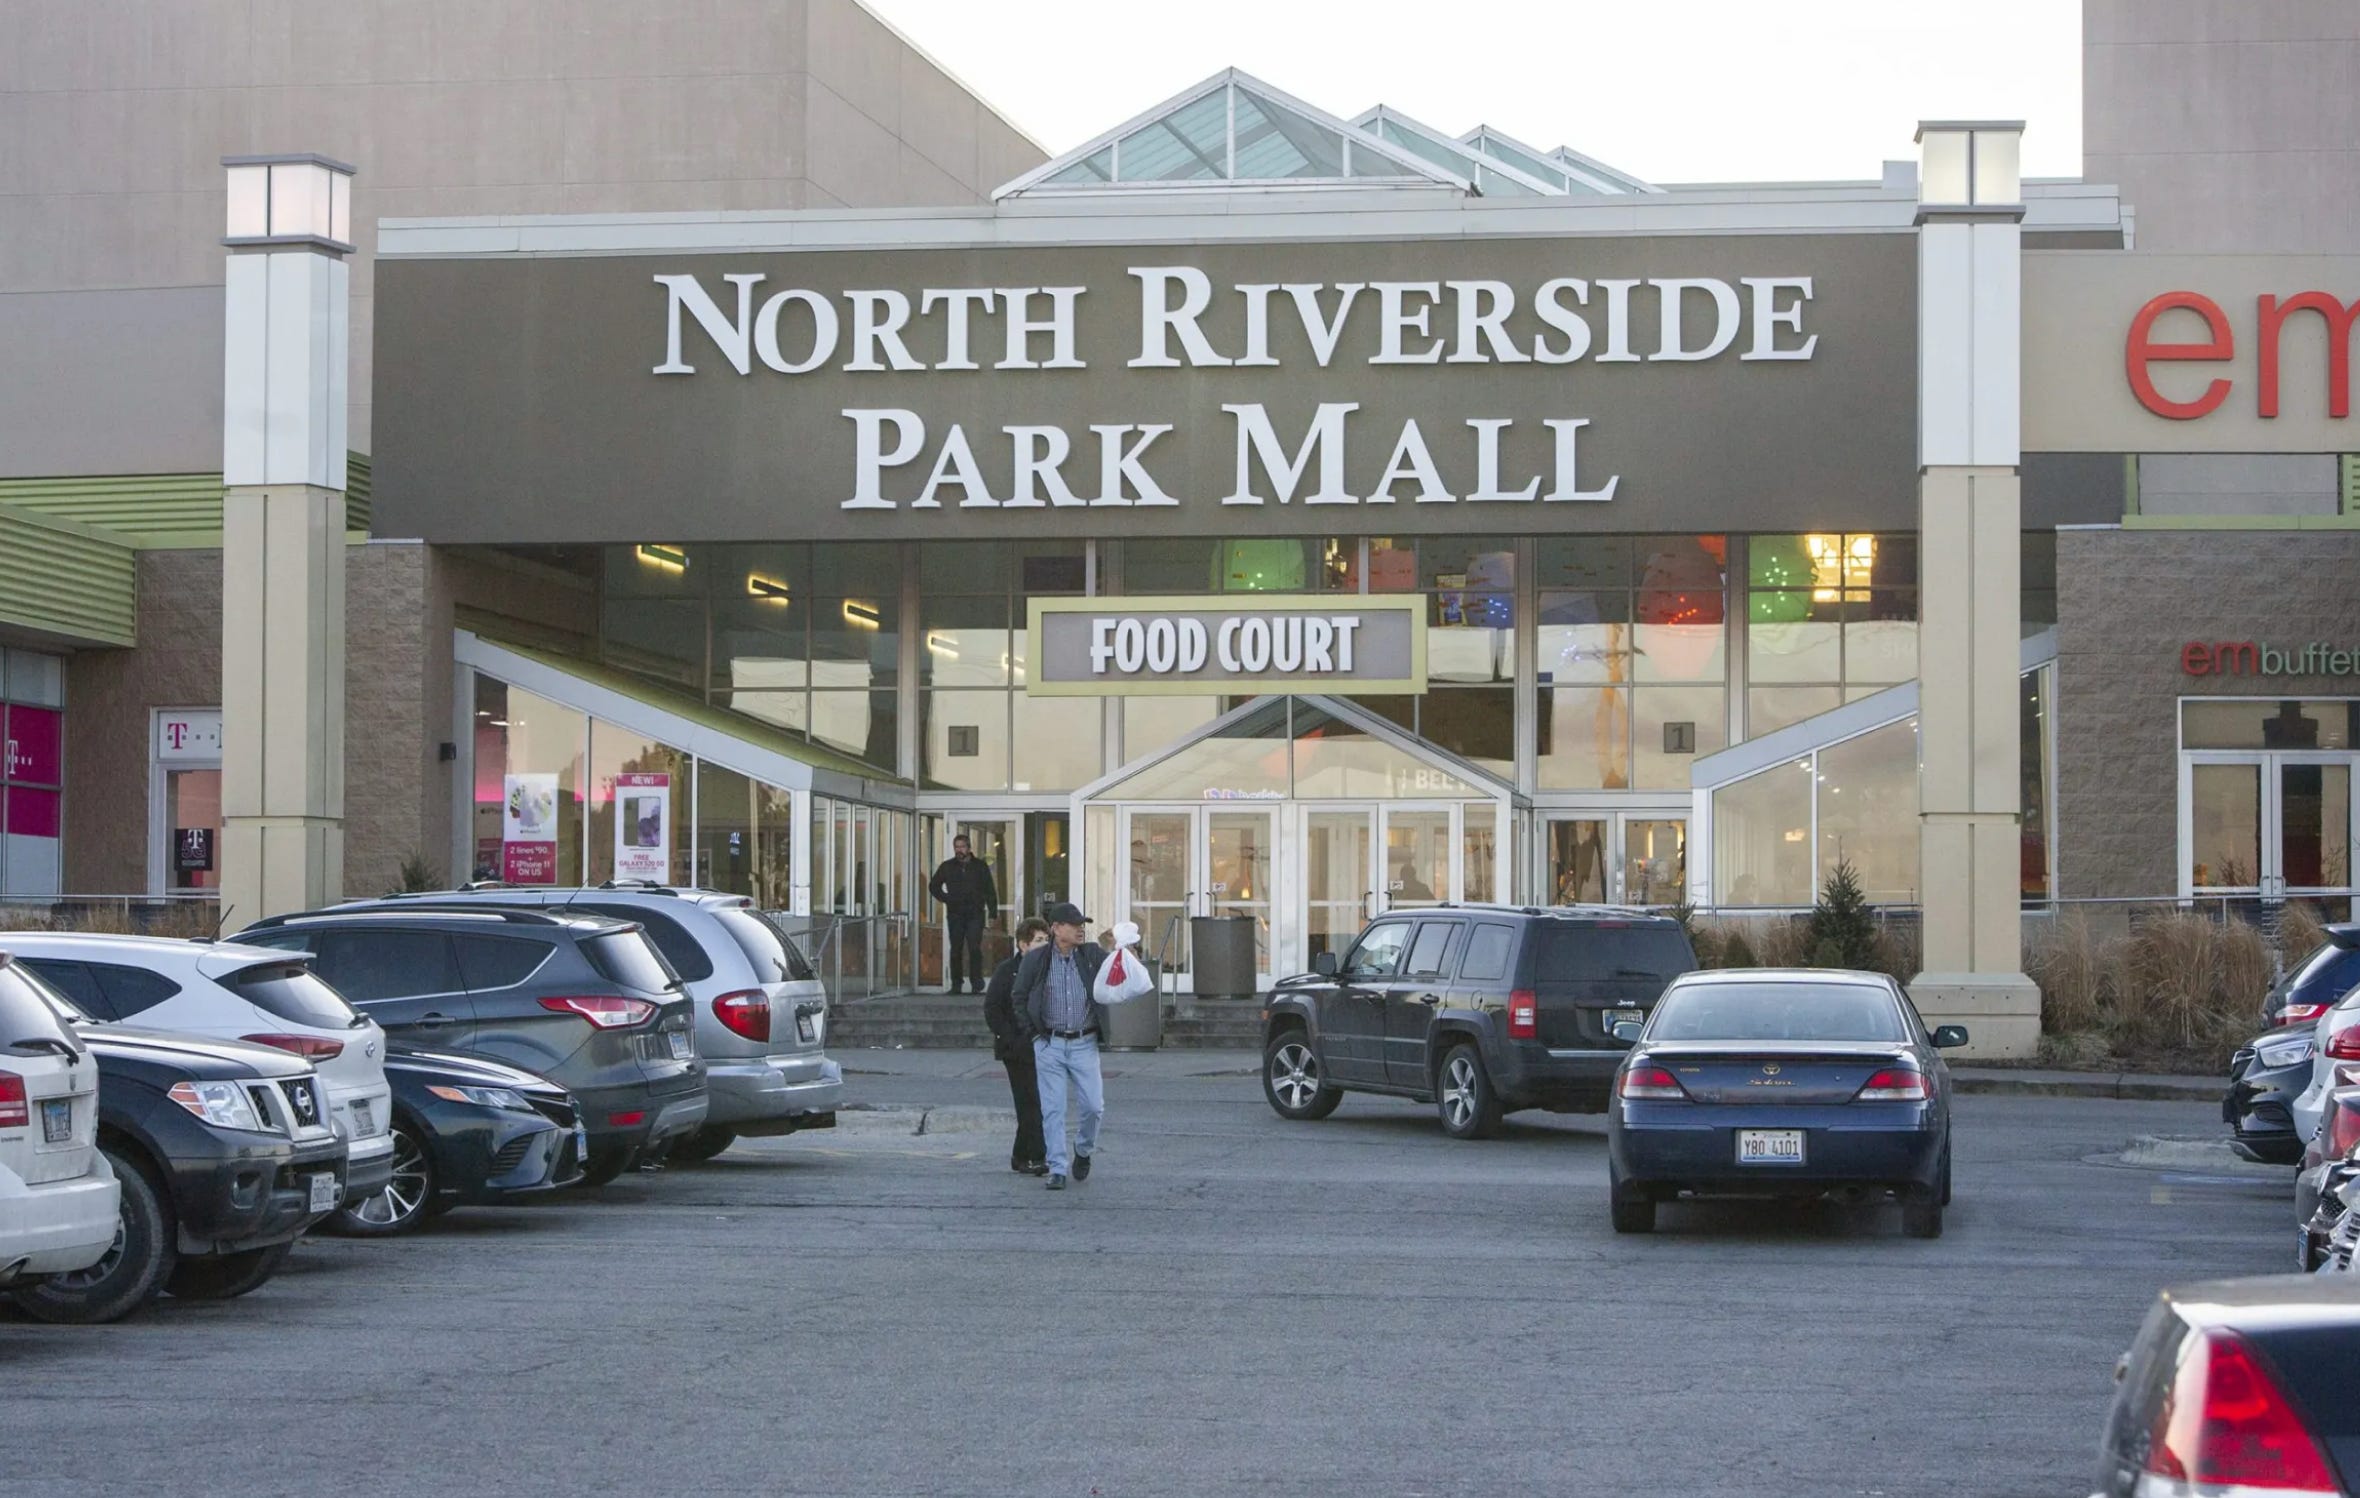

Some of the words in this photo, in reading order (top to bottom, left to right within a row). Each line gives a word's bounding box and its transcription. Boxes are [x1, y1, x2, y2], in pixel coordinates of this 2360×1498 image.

[652, 273, 1087, 375] NORTH
[1127, 266, 1819, 367] RIVERSIDE
[841, 408, 1180, 509] PARK
[1221, 402, 1620, 505] MALL
[1090, 618, 1208, 673] FOOD
[1217, 616, 1360, 673] COURT
[631, 776, 654, 785] NEW!
[516, 846, 534, 854] lines
[516, 860, 542, 869] iPhone
[518, 868, 530, 876] ON
[531, 868, 542, 876] US
[1744, 1139, 1766, 1156] Y80
[1771, 1139, 1799, 1156] 4101
